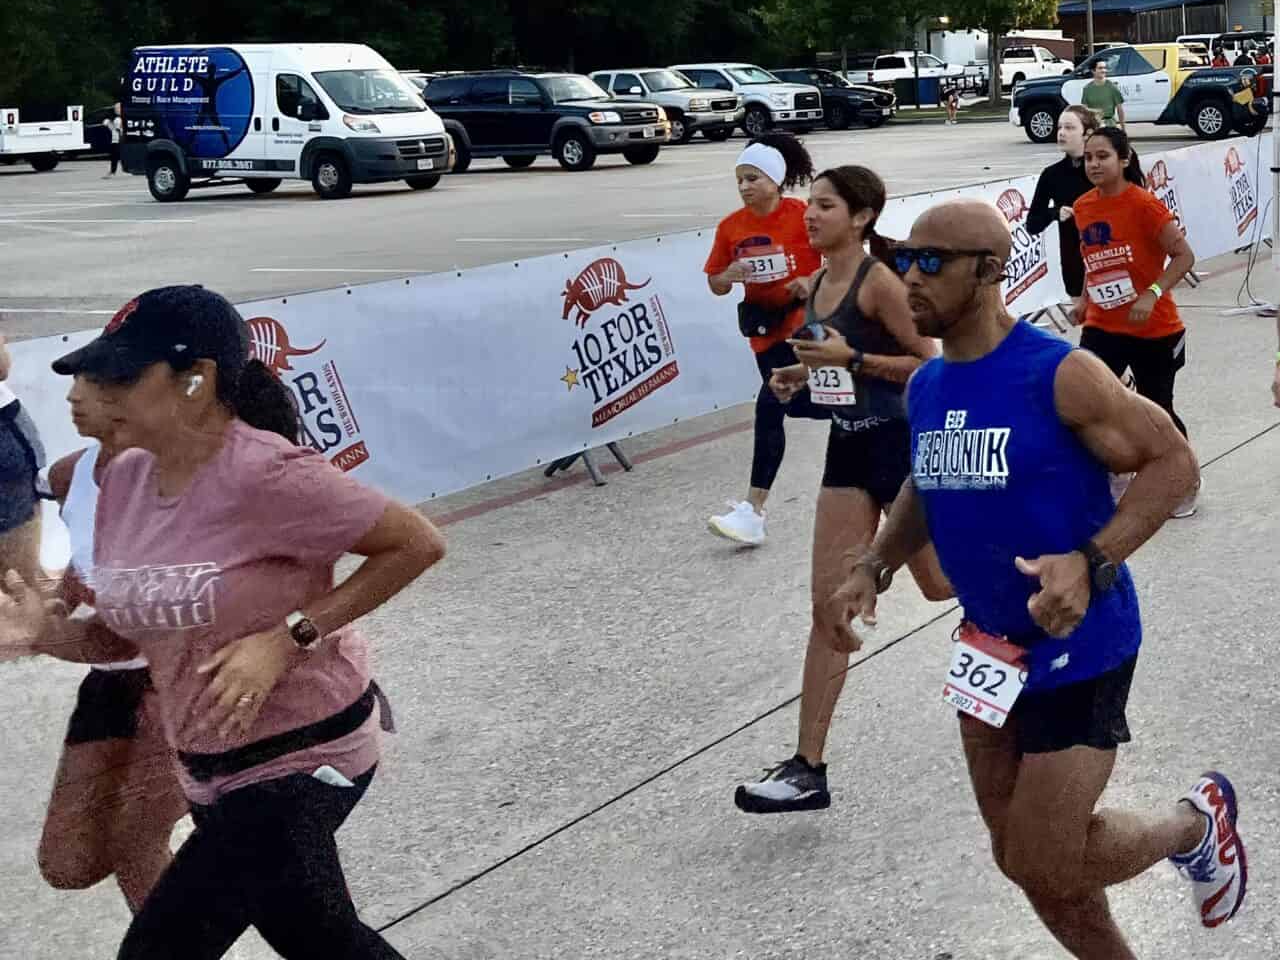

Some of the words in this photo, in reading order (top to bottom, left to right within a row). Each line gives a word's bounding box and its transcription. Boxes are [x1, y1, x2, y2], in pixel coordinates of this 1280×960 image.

[133, 56, 209, 73] ATHLETE
[132, 77, 194, 92] GUILD
[1096, 283, 1124, 300] 151
[571, 332, 602, 373] 10
[600, 302, 653, 355] FOR
[581, 332, 662, 405] TEXAS
[810, 368, 841, 388] 323
[949, 652, 1008, 697] 362
